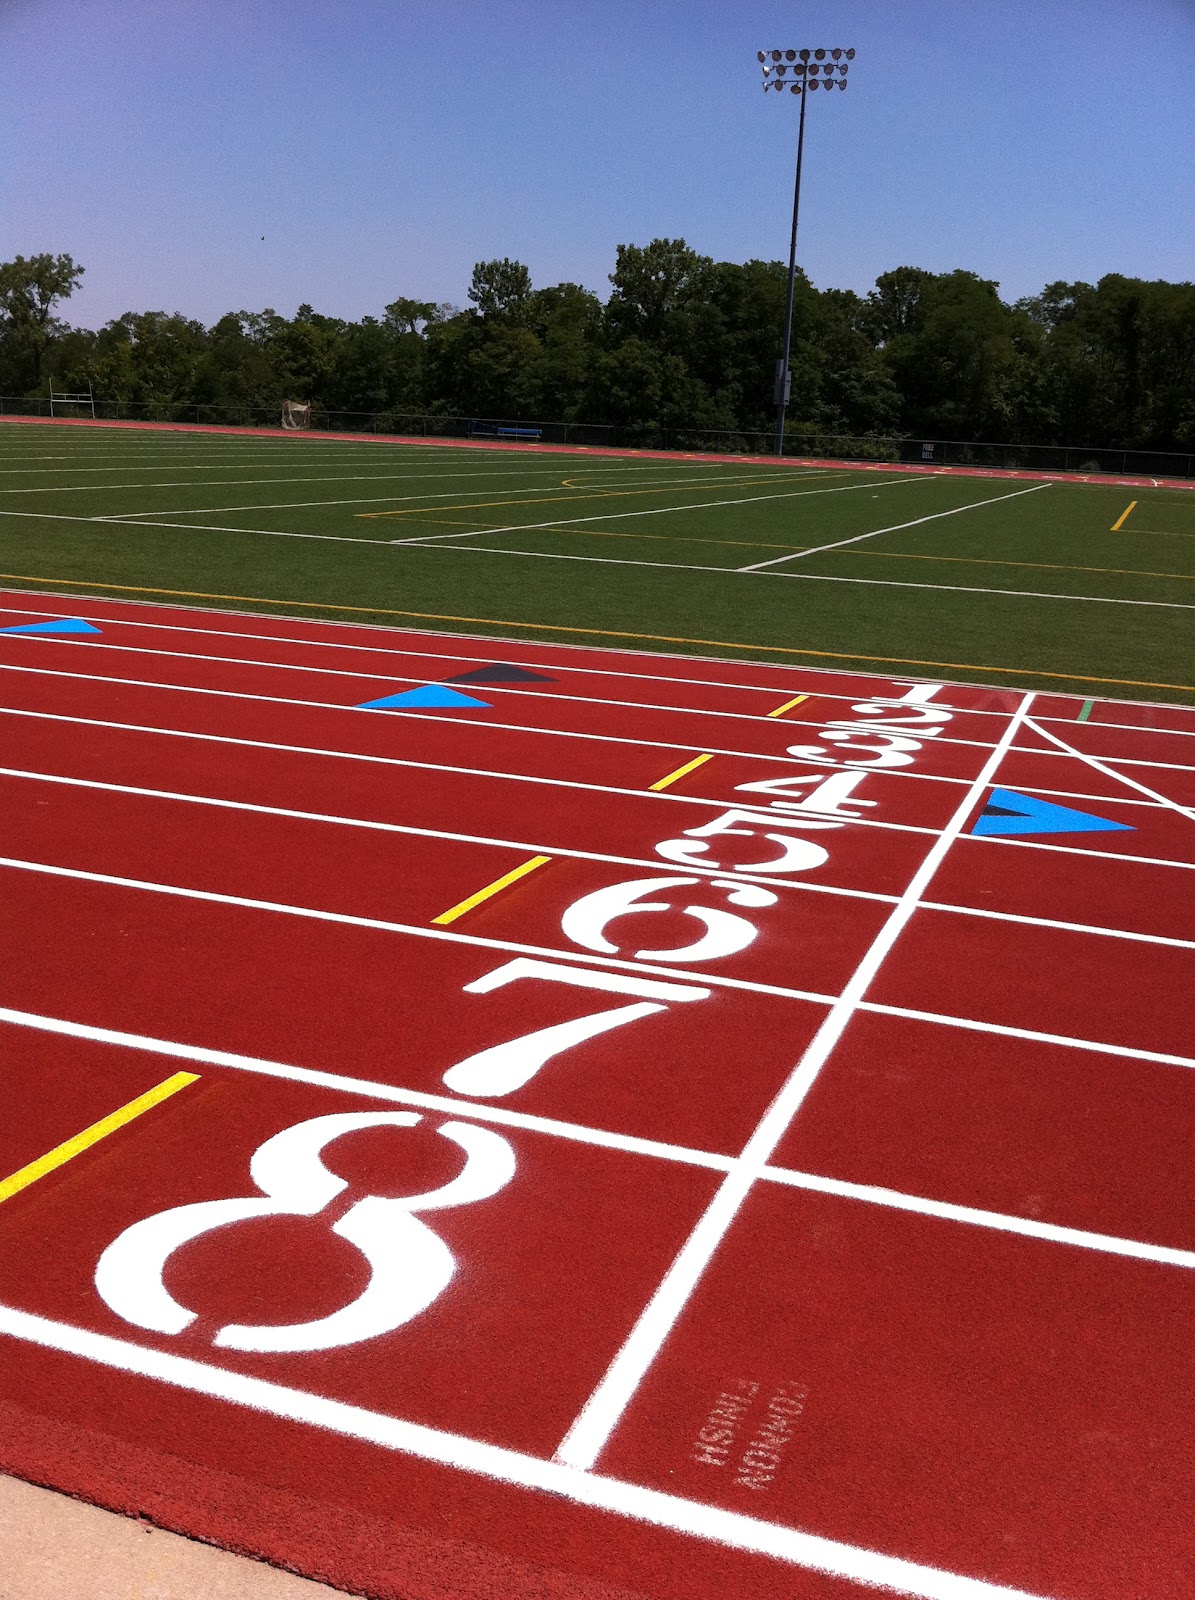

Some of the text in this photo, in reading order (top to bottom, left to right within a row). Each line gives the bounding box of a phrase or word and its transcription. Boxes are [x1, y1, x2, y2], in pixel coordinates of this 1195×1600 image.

[826, 703, 953, 737] 2
[871, 682, 953, 707] 1
[786, 730, 923, 767] 3
[734, 770, 878, 817] 4
[654, 809, 845, 873] 5
[561, 877, 779, 962] 6
[442, 957, 711, 1097] 7
[94, 1111, 517, 1354] 8
